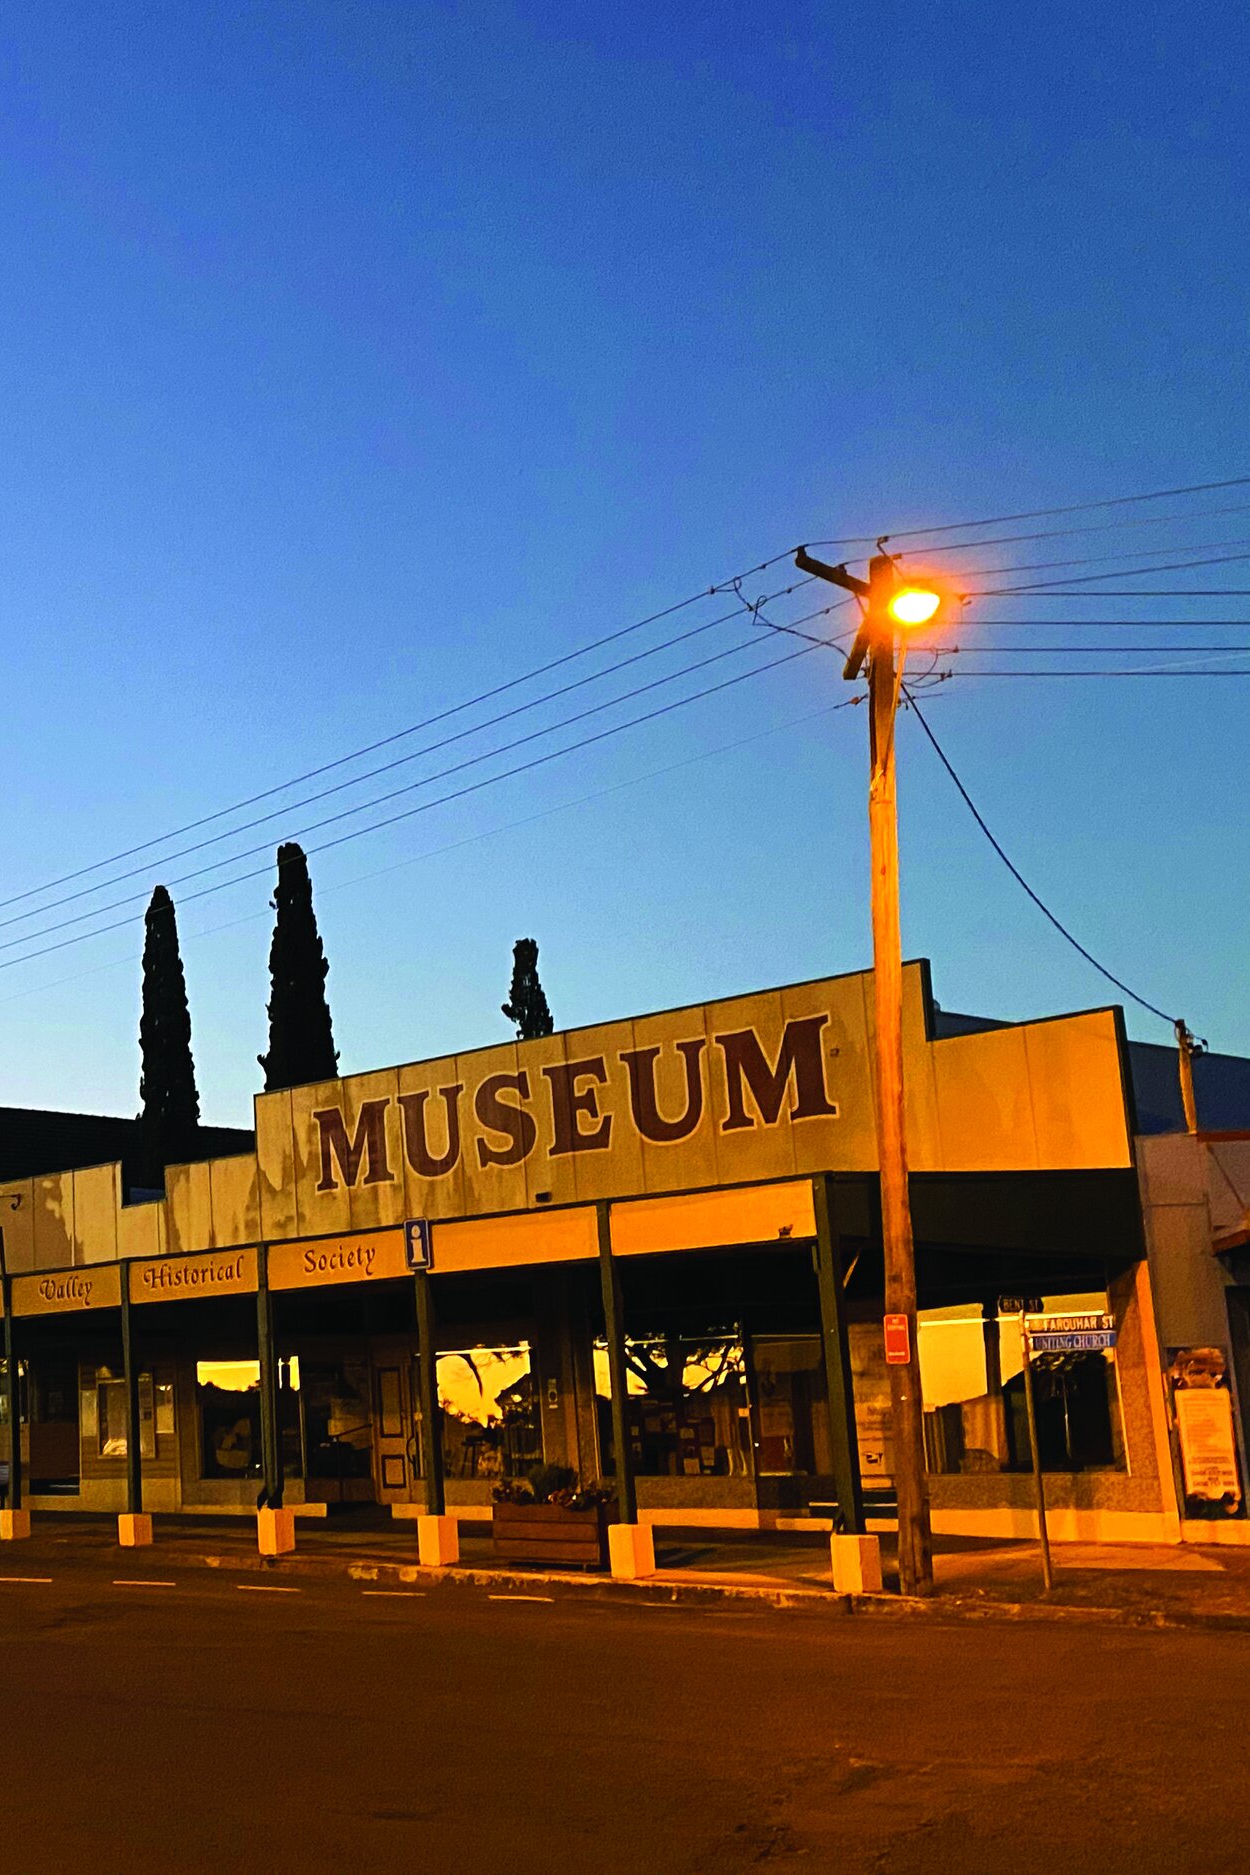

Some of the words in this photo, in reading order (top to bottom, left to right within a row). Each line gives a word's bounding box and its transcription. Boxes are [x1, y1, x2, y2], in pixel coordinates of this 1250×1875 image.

[312, 1013, 838, 1193] MUSEUM
[39, 1275, 93, 1306] Valley
[143, 1255, 245, 1289] Historical
[303, 1245, 376, 1276] Society
[1043, 1316, 1097, 1331] FARQUHAR
[1102, 1314, 1114, 1329] ST
[1073, 1333, 1111, 1349] CHURCH
